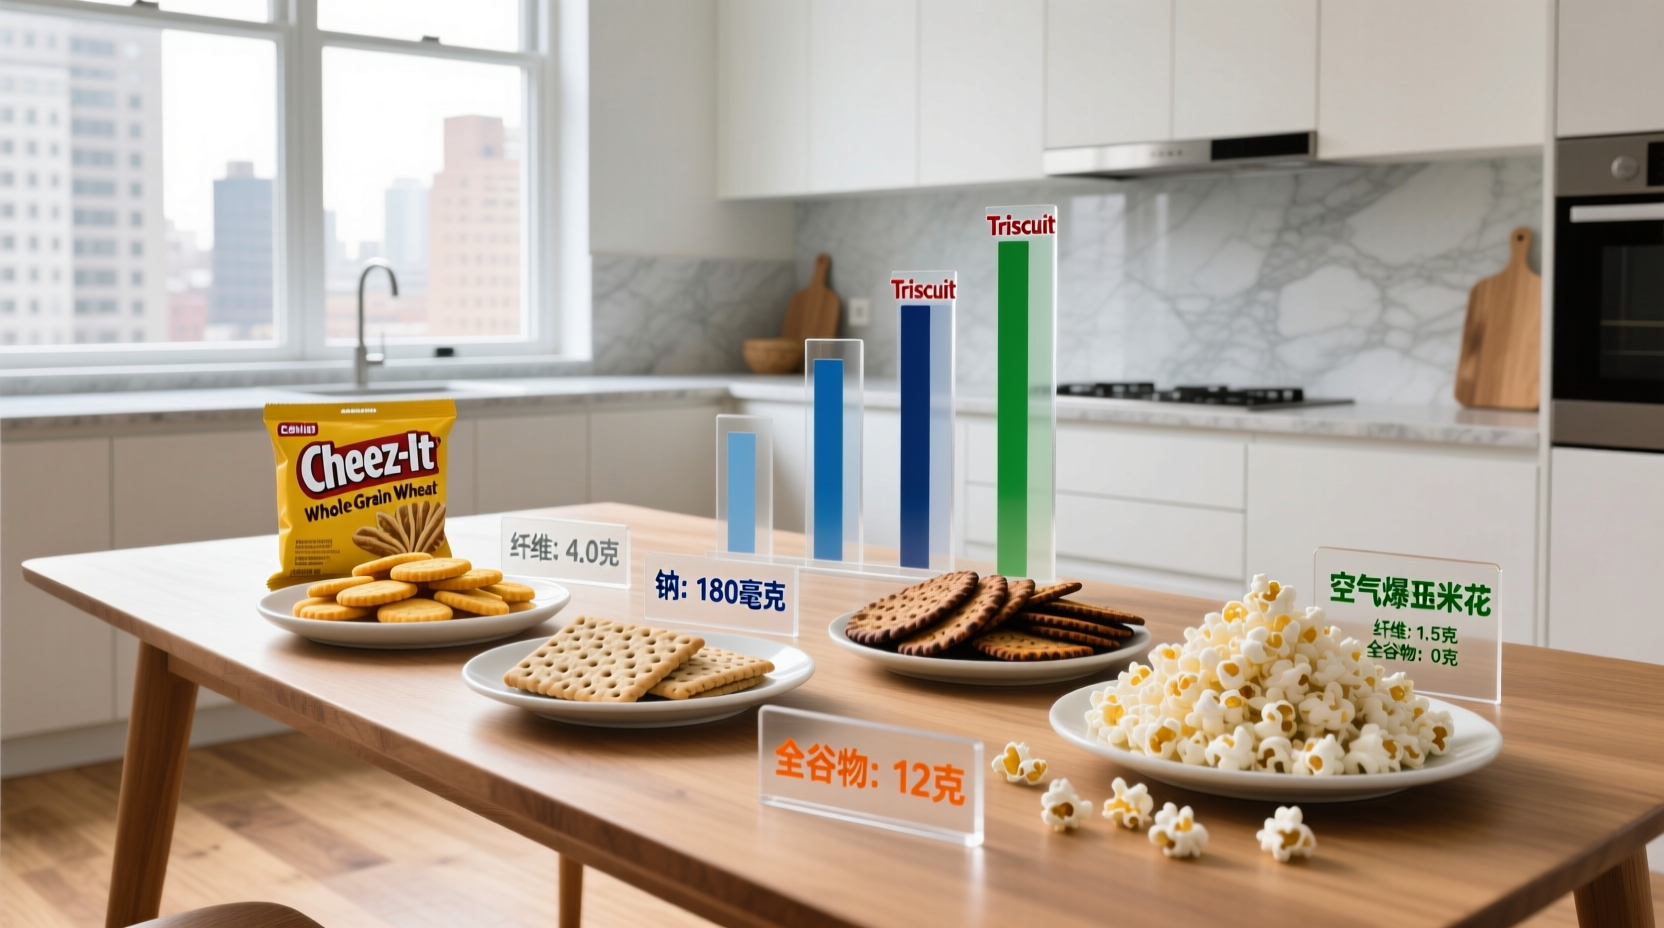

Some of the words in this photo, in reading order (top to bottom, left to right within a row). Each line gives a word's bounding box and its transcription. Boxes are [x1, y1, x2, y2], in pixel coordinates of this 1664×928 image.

[986, 214, 1056, 236] Triscuit
[890, 278, 956, 299] Triscuit
[301, 433, 435, 493] Cheez-It
[304, 498, 352, 522] Whole
[354, 489, 392, 510] Grain
[394, 481, 438, 501] Wheat
